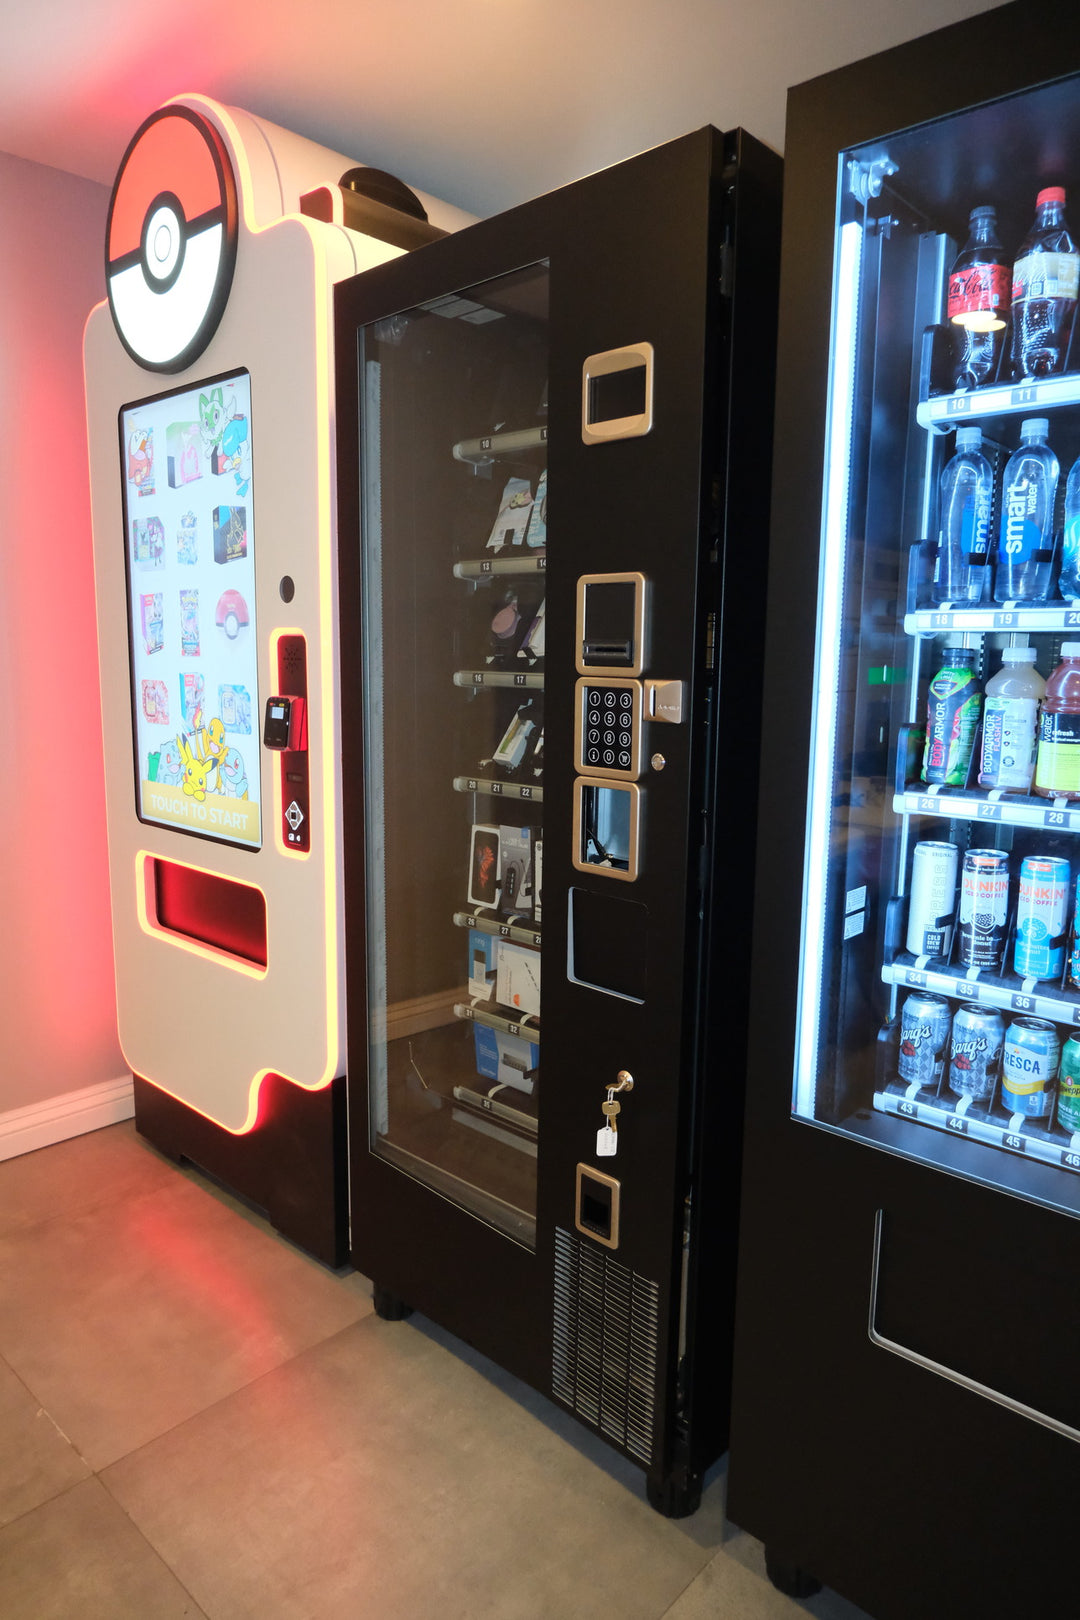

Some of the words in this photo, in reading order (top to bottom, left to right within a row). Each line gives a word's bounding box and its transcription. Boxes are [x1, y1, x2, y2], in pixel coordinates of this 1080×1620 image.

[1018, 388, 1031, 400] 11
[952, 398, 965, 410] 10
[481, 439, 490, 448] 10
[1027, 483, 1038, 515] water
[976, 486, 990, 554] smart
[1005, 478, 1028, 554] smart
[482, 562, 490, 571] 13
[935, 614, 948, 625] 18
[999, 613, 1013, 625] 19
[474, 674, 482, 683] 16
[516, 675, 524, 684] 17
[608, 697, 613, 705] 2
[592, 713, 597, 722] 4
[607, 715, 612, 723] 5
[622, 716, 628, 724] 6
[592, 732, 597, 740] 7
[607, 734, 612, 742] 8
[622, 735, 628, 744] 9
[931, 701, 946, 767] BODYARMOR
[983, 714, 995, 774] BODYARMOR
[993, 728, 1002, 752] FLASH
[606, 752, 611, 761] 0
[469, 780, 476, 789] 20
[493, 783, 500, 792] 21
[522, 787, 530, 797] 22
[921, 799, 935, 809] 26
[150, 793, 188, 817] TOUCH
[190, 803, 207, 820] TO
[209, 807, 248, 831] START
[982, 804, 996, 816] 27
[1048, 811, 1064, 824] 28
[468, 917, 475, 926] 26
[501, 926, 509, 935] 27
[909, 972, 921, 984] 34
[960, 984, 973, 995] 35
[1015, 996, 1030, 1008] 36
[509, 1024, 518, 1034] 32
[900, 1024, 932, 1049] arq's
[1004, 1051, 1041, 1075] RESCA
[900, 1102, 913, 1114] 43
[949, 1117, 963, 1130] 44
[1006, 1135, 1020, 1148] 45
[1065, 1152, 1080, 1166] 46
